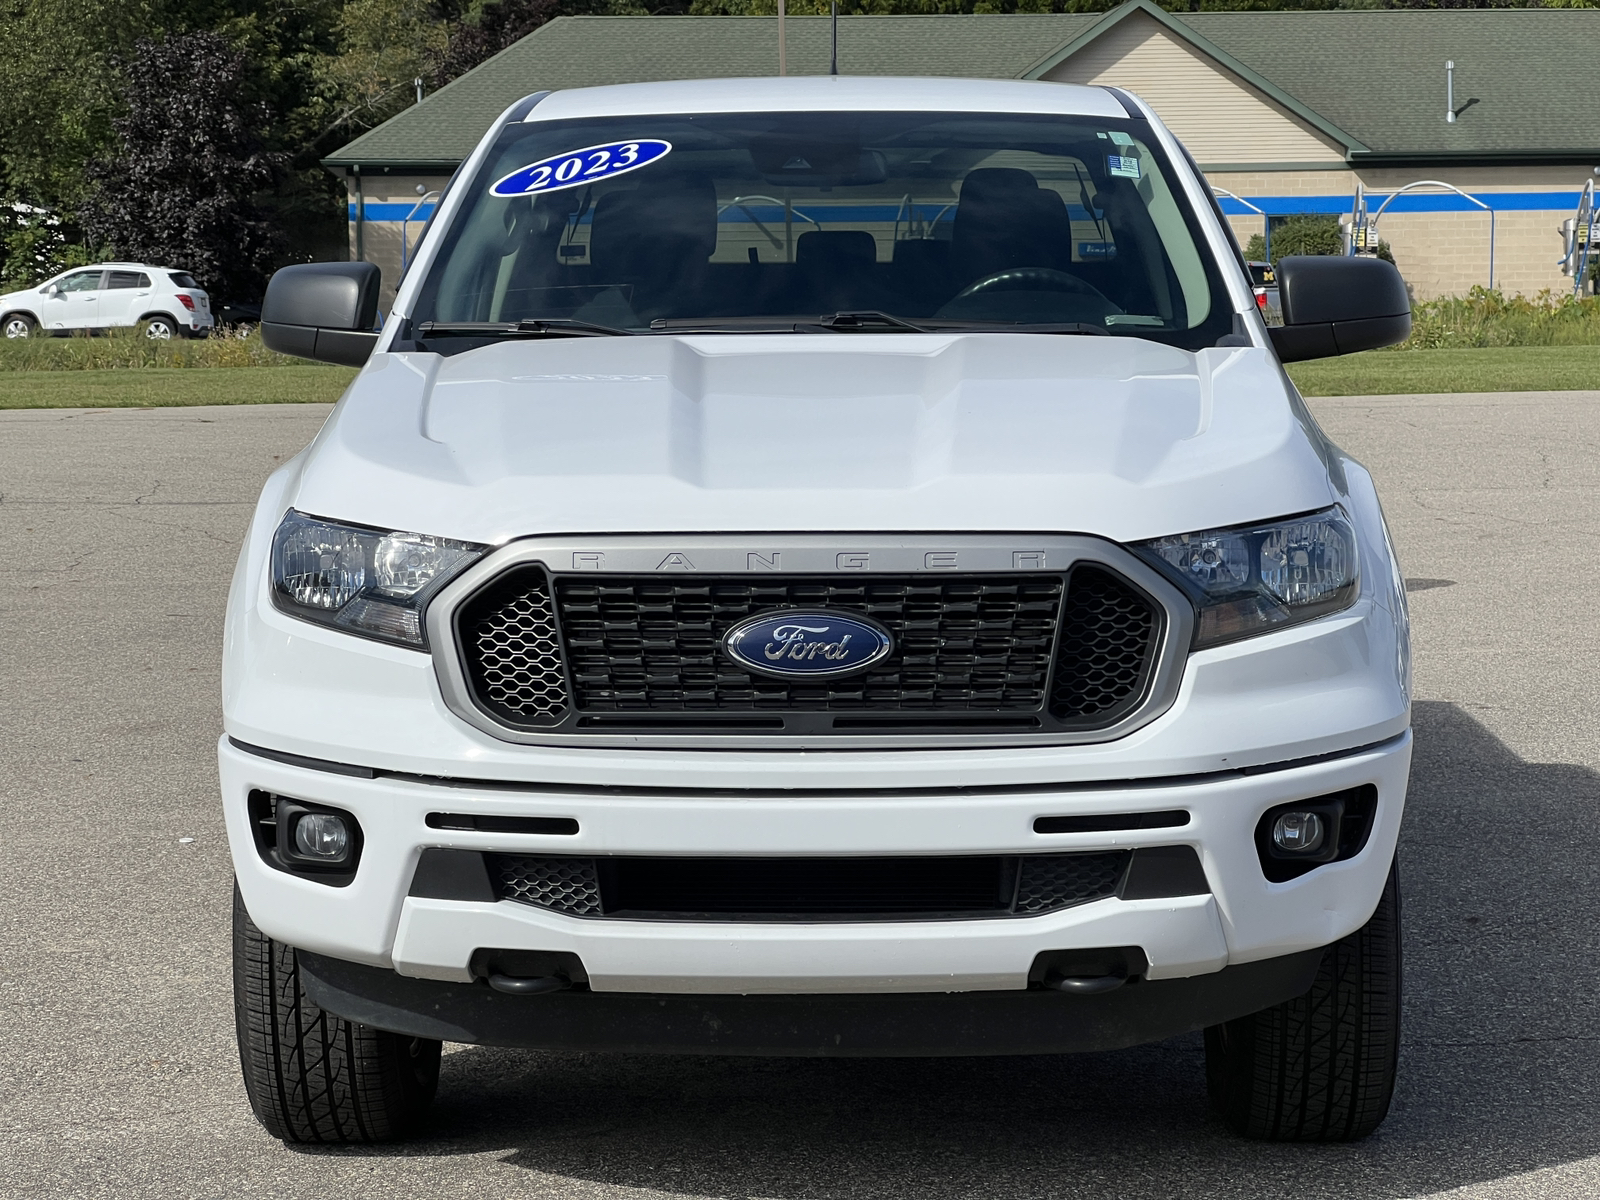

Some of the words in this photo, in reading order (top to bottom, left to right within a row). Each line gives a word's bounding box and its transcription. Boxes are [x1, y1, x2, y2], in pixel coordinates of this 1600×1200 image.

[524, 144, 640, 191] 2023
[1263, 271, 1275, 281] M
[572, 551, 1046, 570] RANGER
[764, 624, 852, 660] Ford
